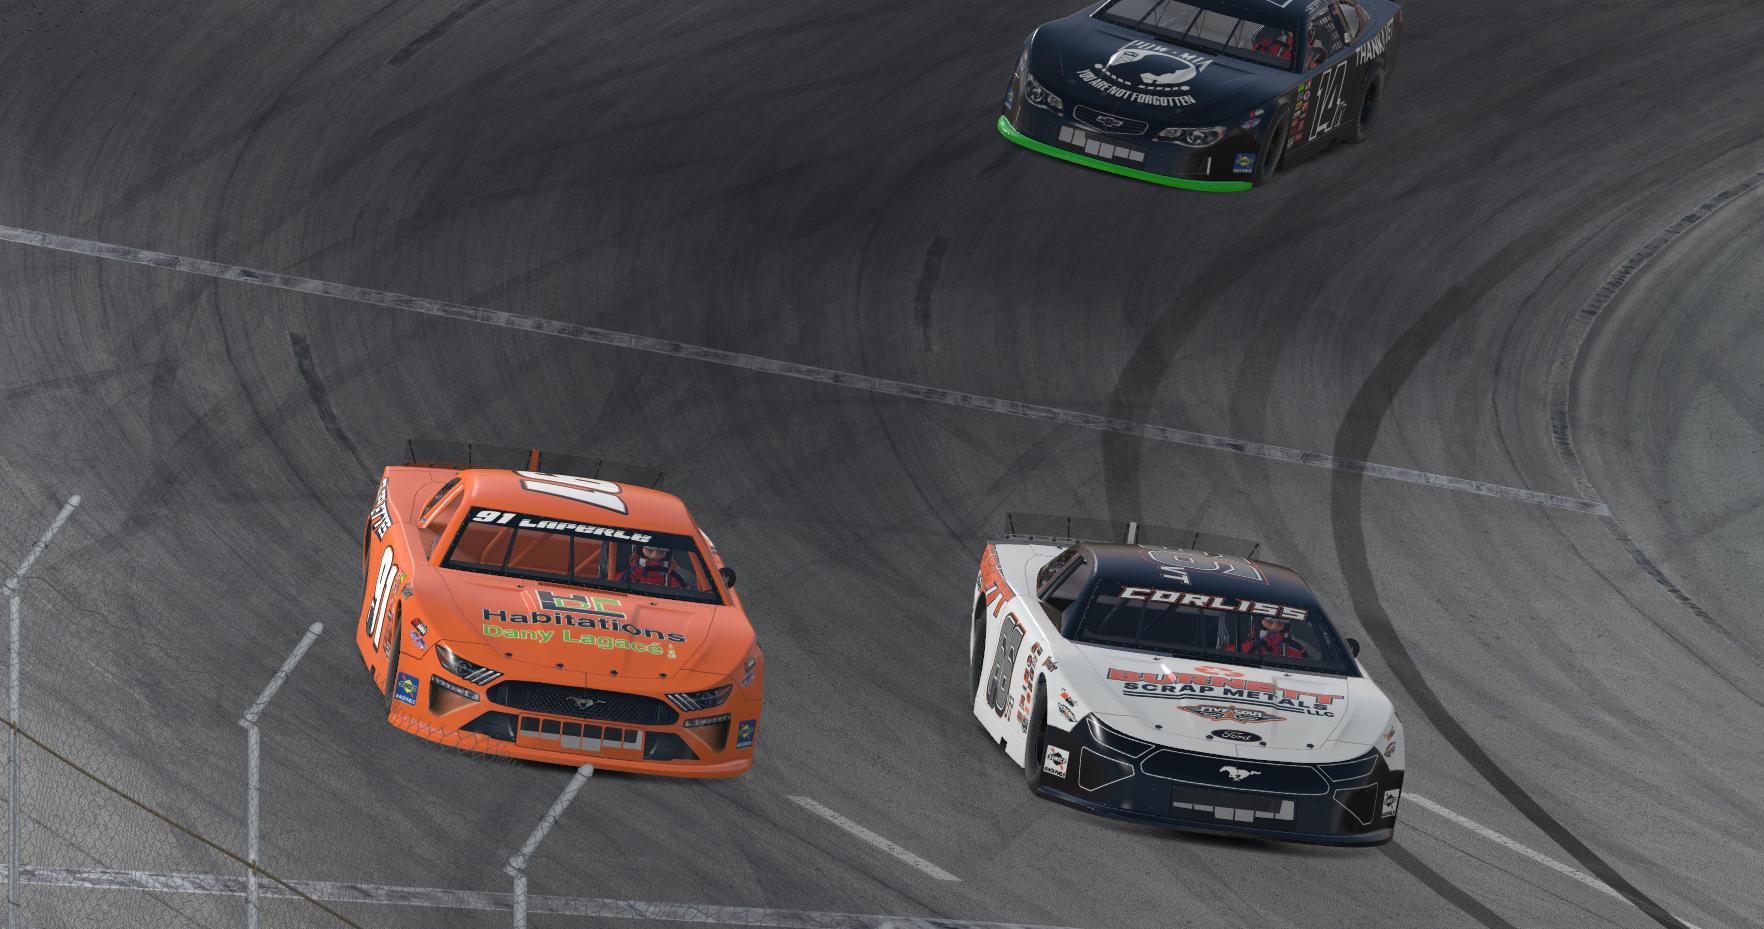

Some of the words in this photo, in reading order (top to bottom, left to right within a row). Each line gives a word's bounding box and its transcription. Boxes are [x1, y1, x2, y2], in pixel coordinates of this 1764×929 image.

[1355, 33, 1386, 66] THANK
[1077, 68, 1097, 83] YOU
[1089, 77, 1113, 92] ARE
[1107, 85, 1132, 100] NOT
[1130, 92, 1197, 107] FORGOTTEN
[1308, 60, 1348, 141] 14
[471, 510, 516, 525] 91
[517, 518, 653, 543] LAPERLE
[365, 544, 398, 653] 91
[1119, 585, 1309, 622] CORLISS
[481, 607, 688, 643] Habitations
[481, 624, 555, 643] Dany
[561, 629, 665, 655] Lagacé
[1107, 667, 1345, 706] BURNETT
[1123, 682, 1215, 694] SCRAP
[1222, 687, 1330, 711] METALS
[1306, 709, 1335, 718] LLC
[1222, 730, 1253, 742] Ford
